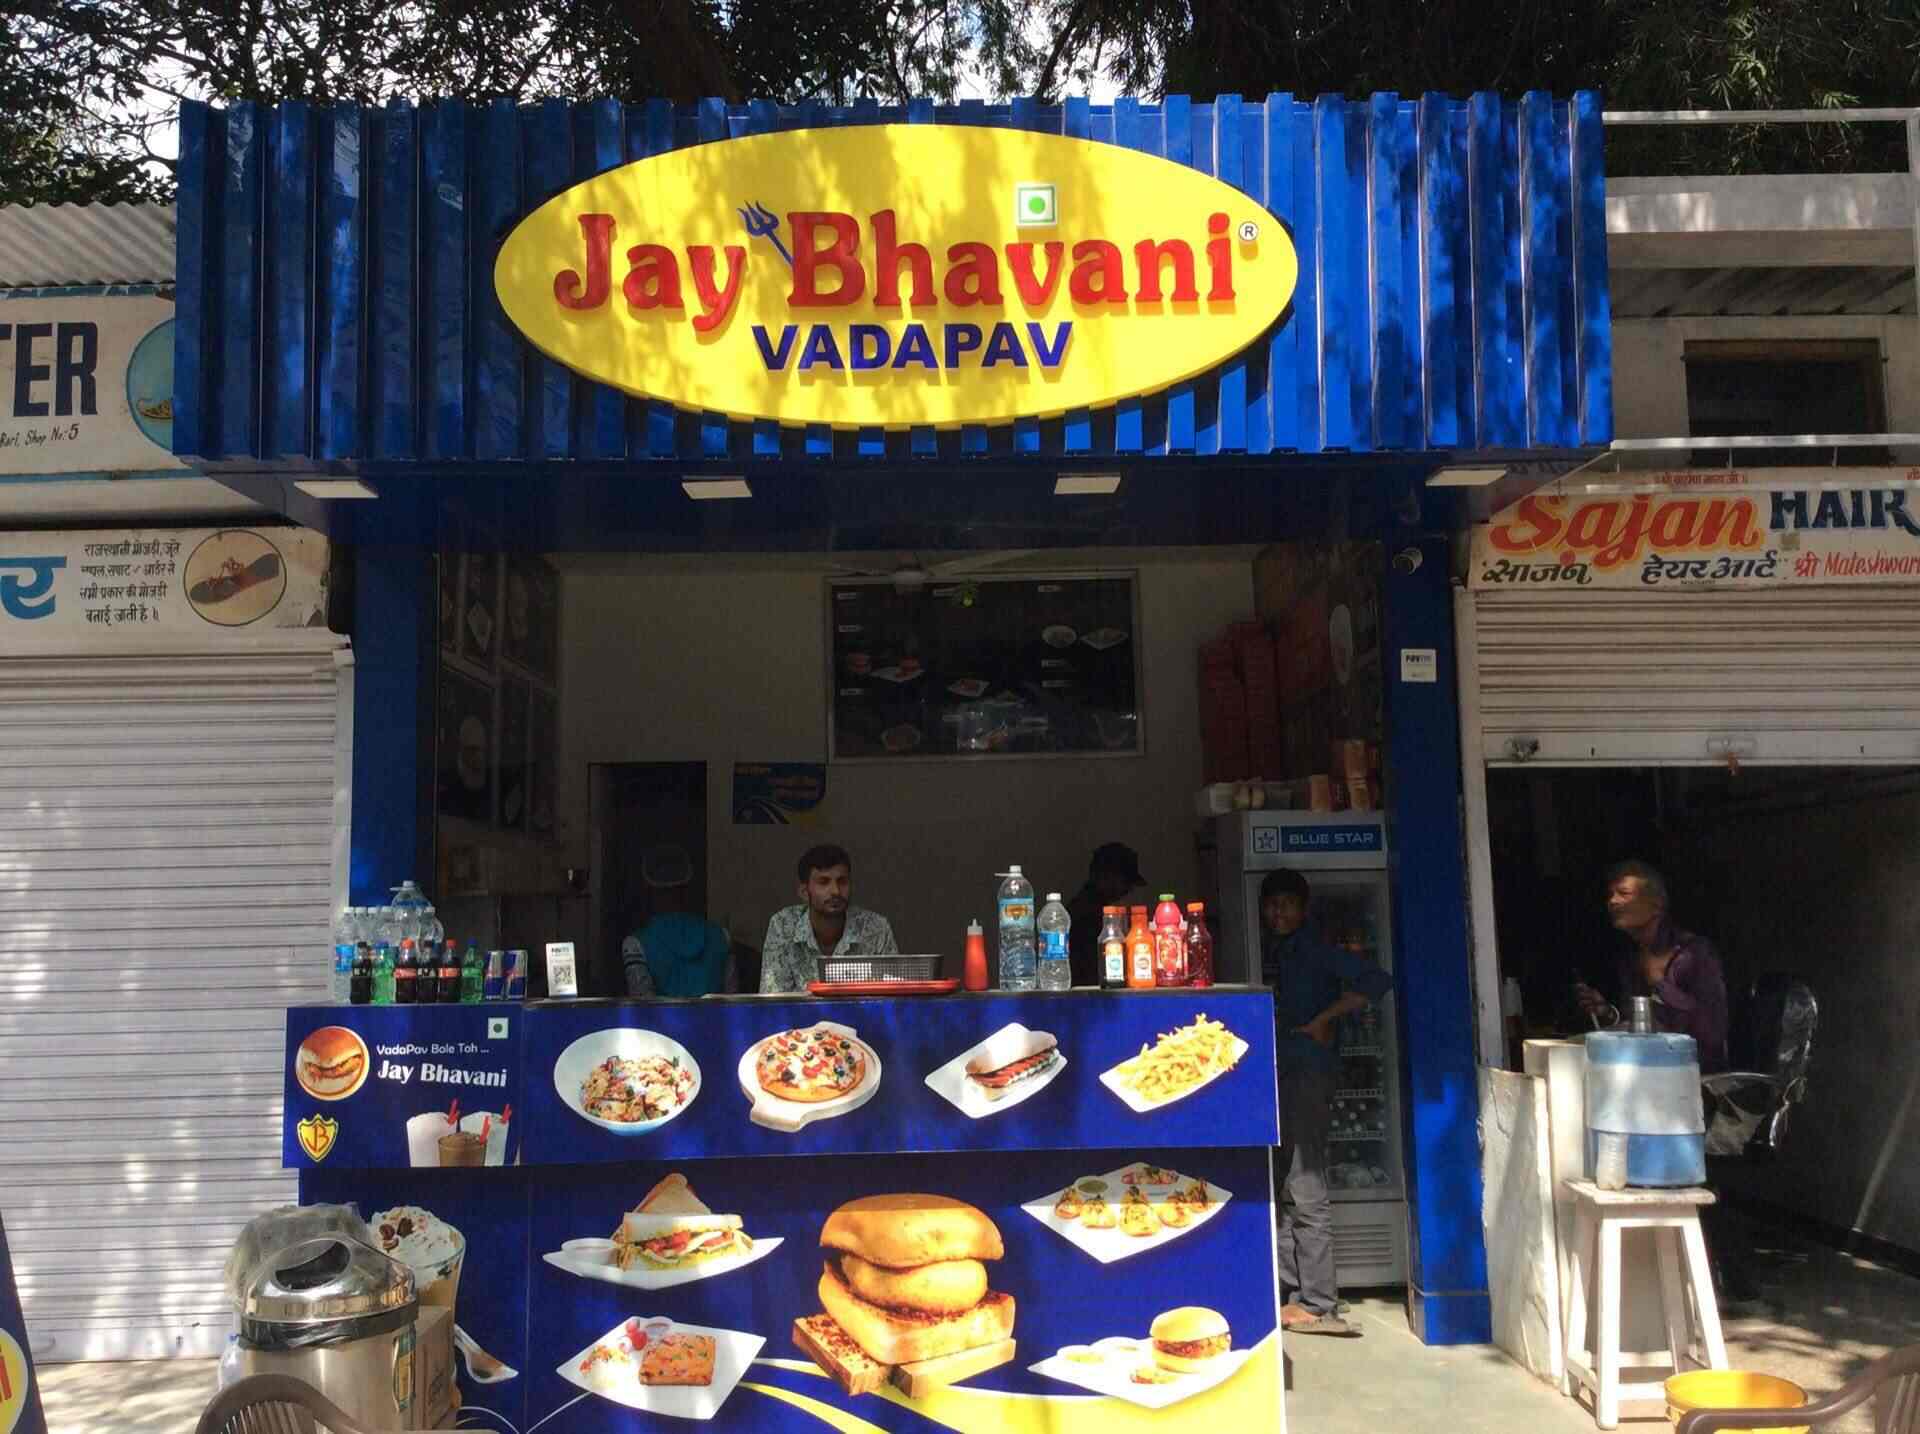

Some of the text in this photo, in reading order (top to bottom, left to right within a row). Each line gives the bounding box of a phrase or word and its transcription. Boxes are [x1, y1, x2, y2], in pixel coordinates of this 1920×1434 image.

[553, 213, 747, 332] Jay
[787, 209, 1237, 308] Bhavani
[751, 321, 1073, 370] VADAPAV
[1488, 489, 1920, 568] Sajan HAIR
[1288, 832, 1375, 845] BLUE STAR
[432, 1043, 455, 1054] Bole
[377, 1060, 508, 1088] Jay Bhavani
